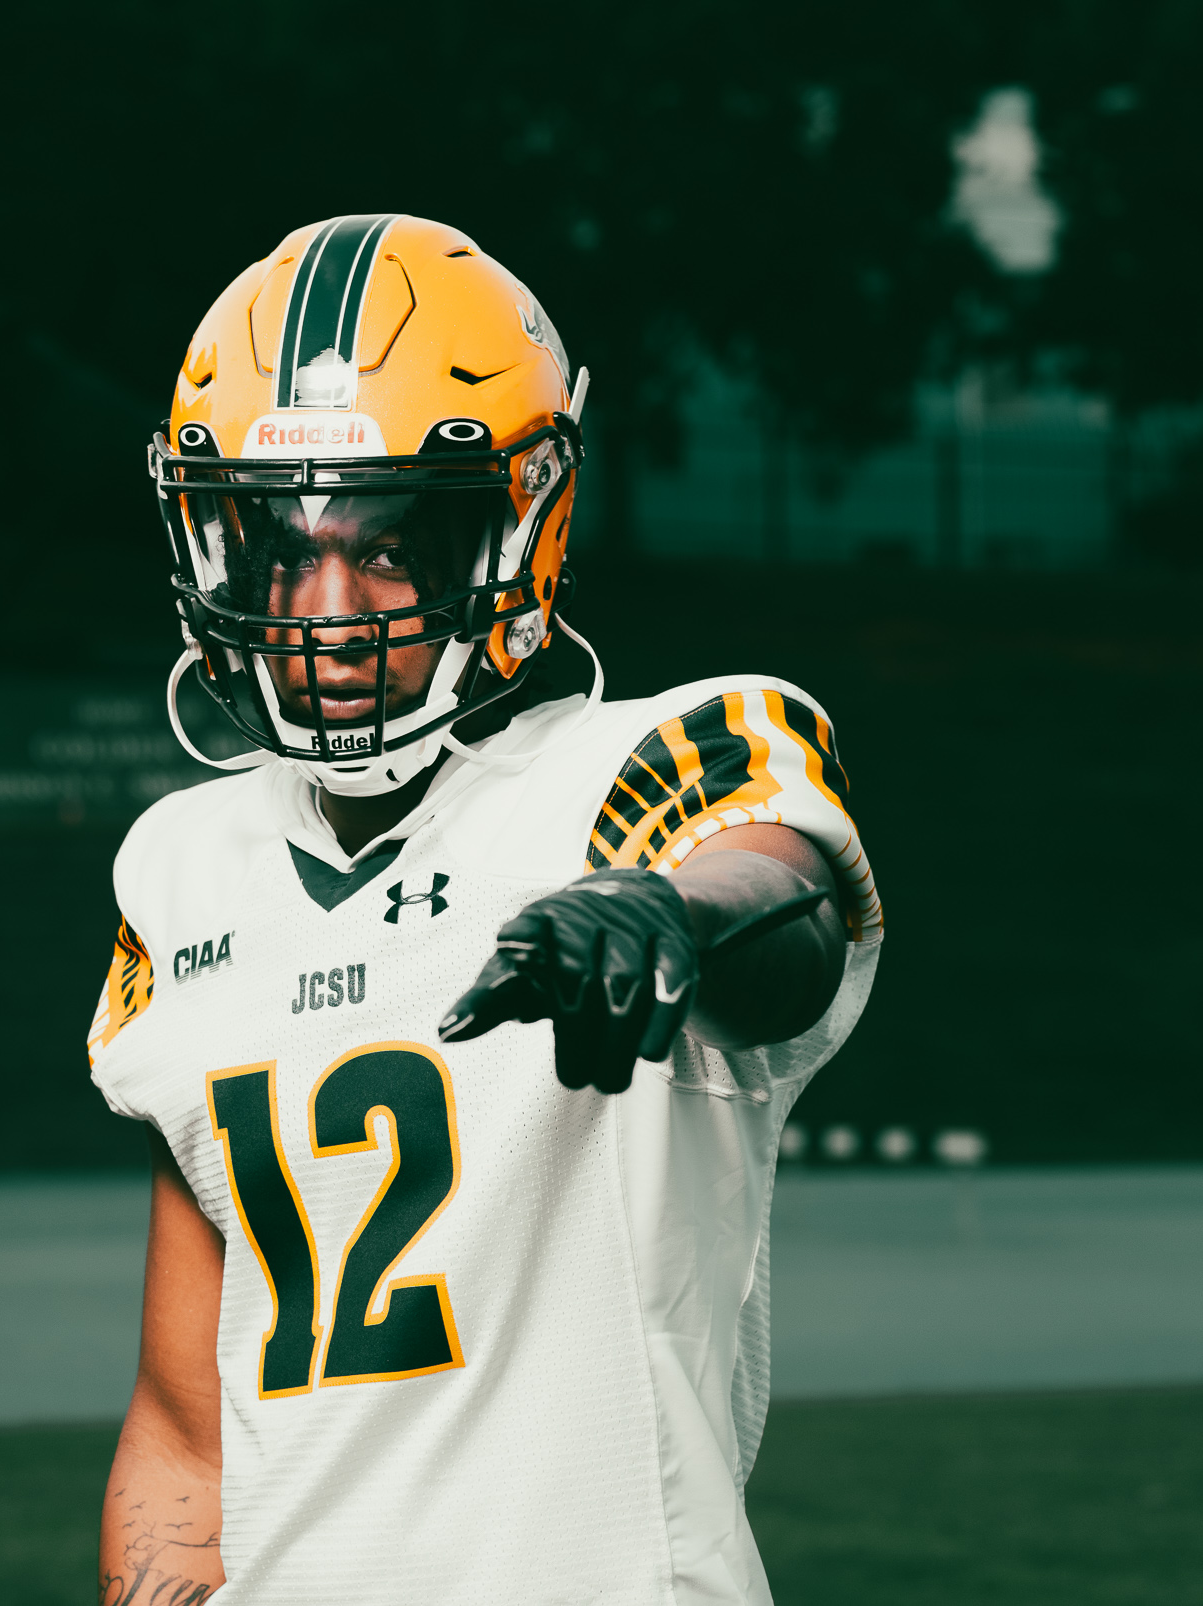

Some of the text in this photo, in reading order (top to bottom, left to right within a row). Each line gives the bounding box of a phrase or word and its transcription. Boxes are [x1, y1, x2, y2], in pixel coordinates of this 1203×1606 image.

[258, 421, 365, 445] Riddell
[310, 732, 376, 750] Rddel
[173, 931, 234, 986] CIAA
[291, 962, 366, 1015] JCSU
[205, 1040, 466, 1401] 12
